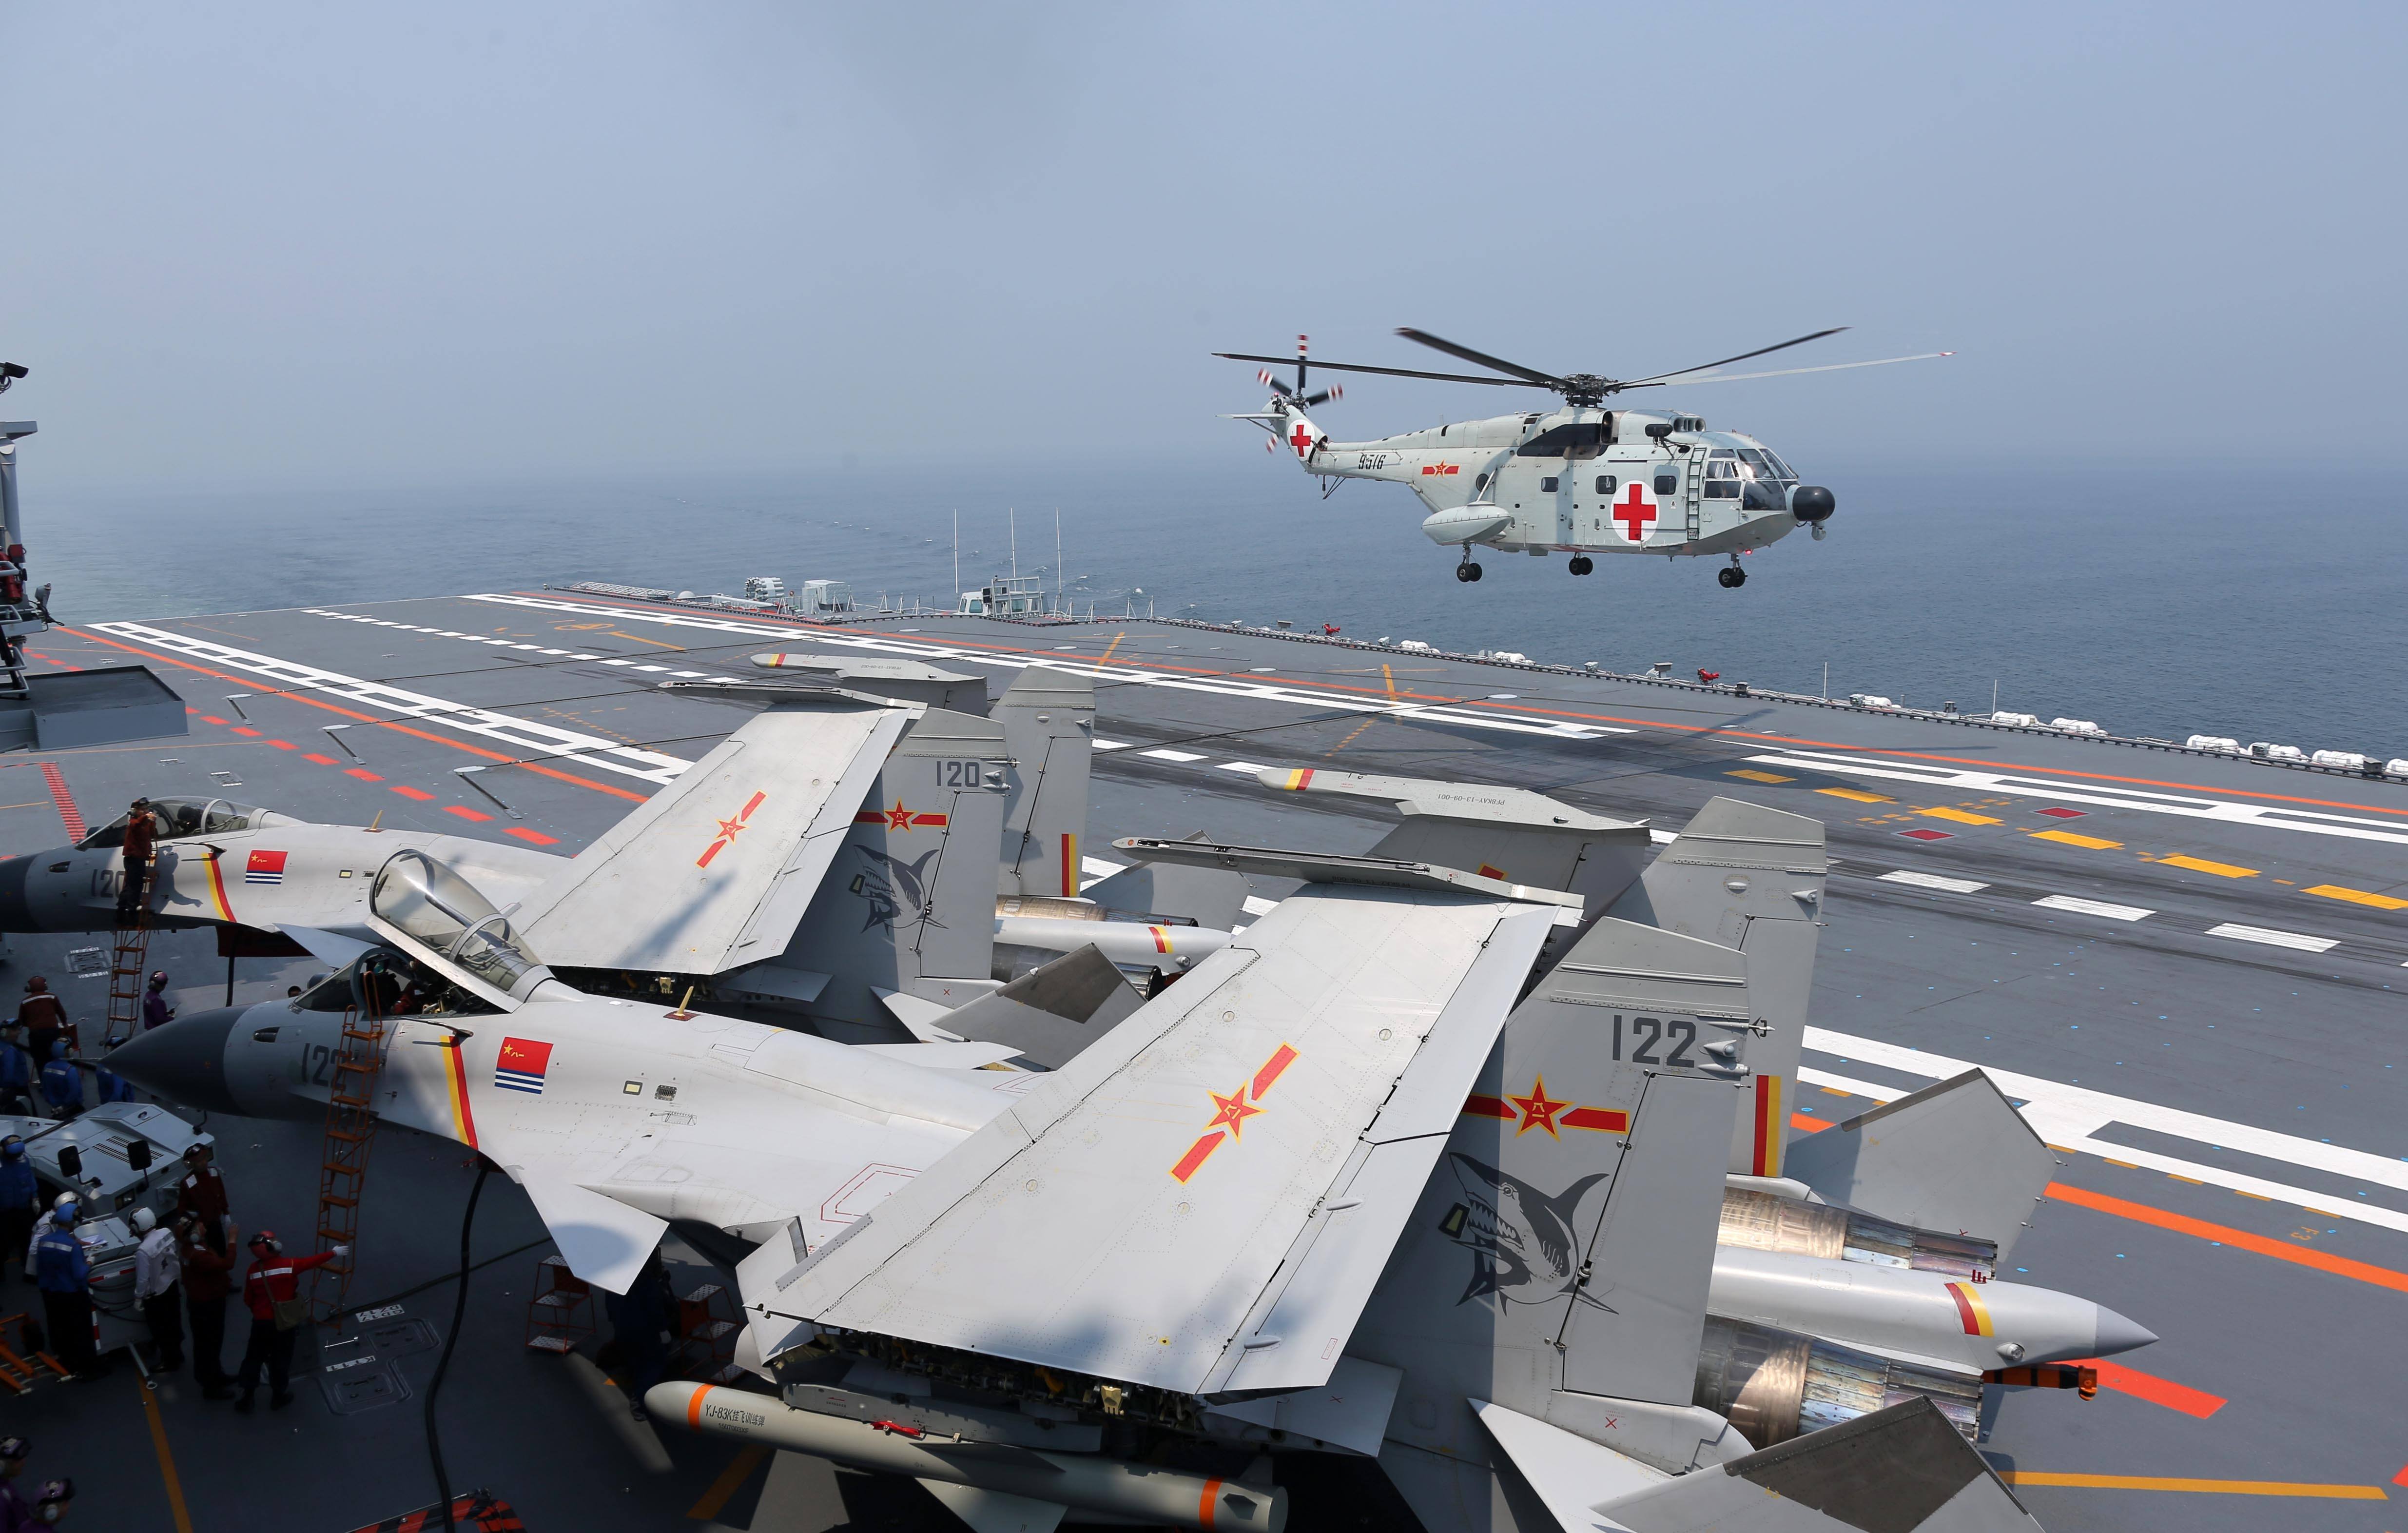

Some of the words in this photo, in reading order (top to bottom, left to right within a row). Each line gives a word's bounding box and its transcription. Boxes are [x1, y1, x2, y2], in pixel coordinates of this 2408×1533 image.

[1359, 454, 1386, 470] 9516
[937, 761, 980, 787] 120
[1438, 794, 1505, 805] PF8KAY-13-09-001
[1612, 1015, 1696, 1068] 122
[705, 1404, 765, 1427] YJ-83K挂飞训练弹
